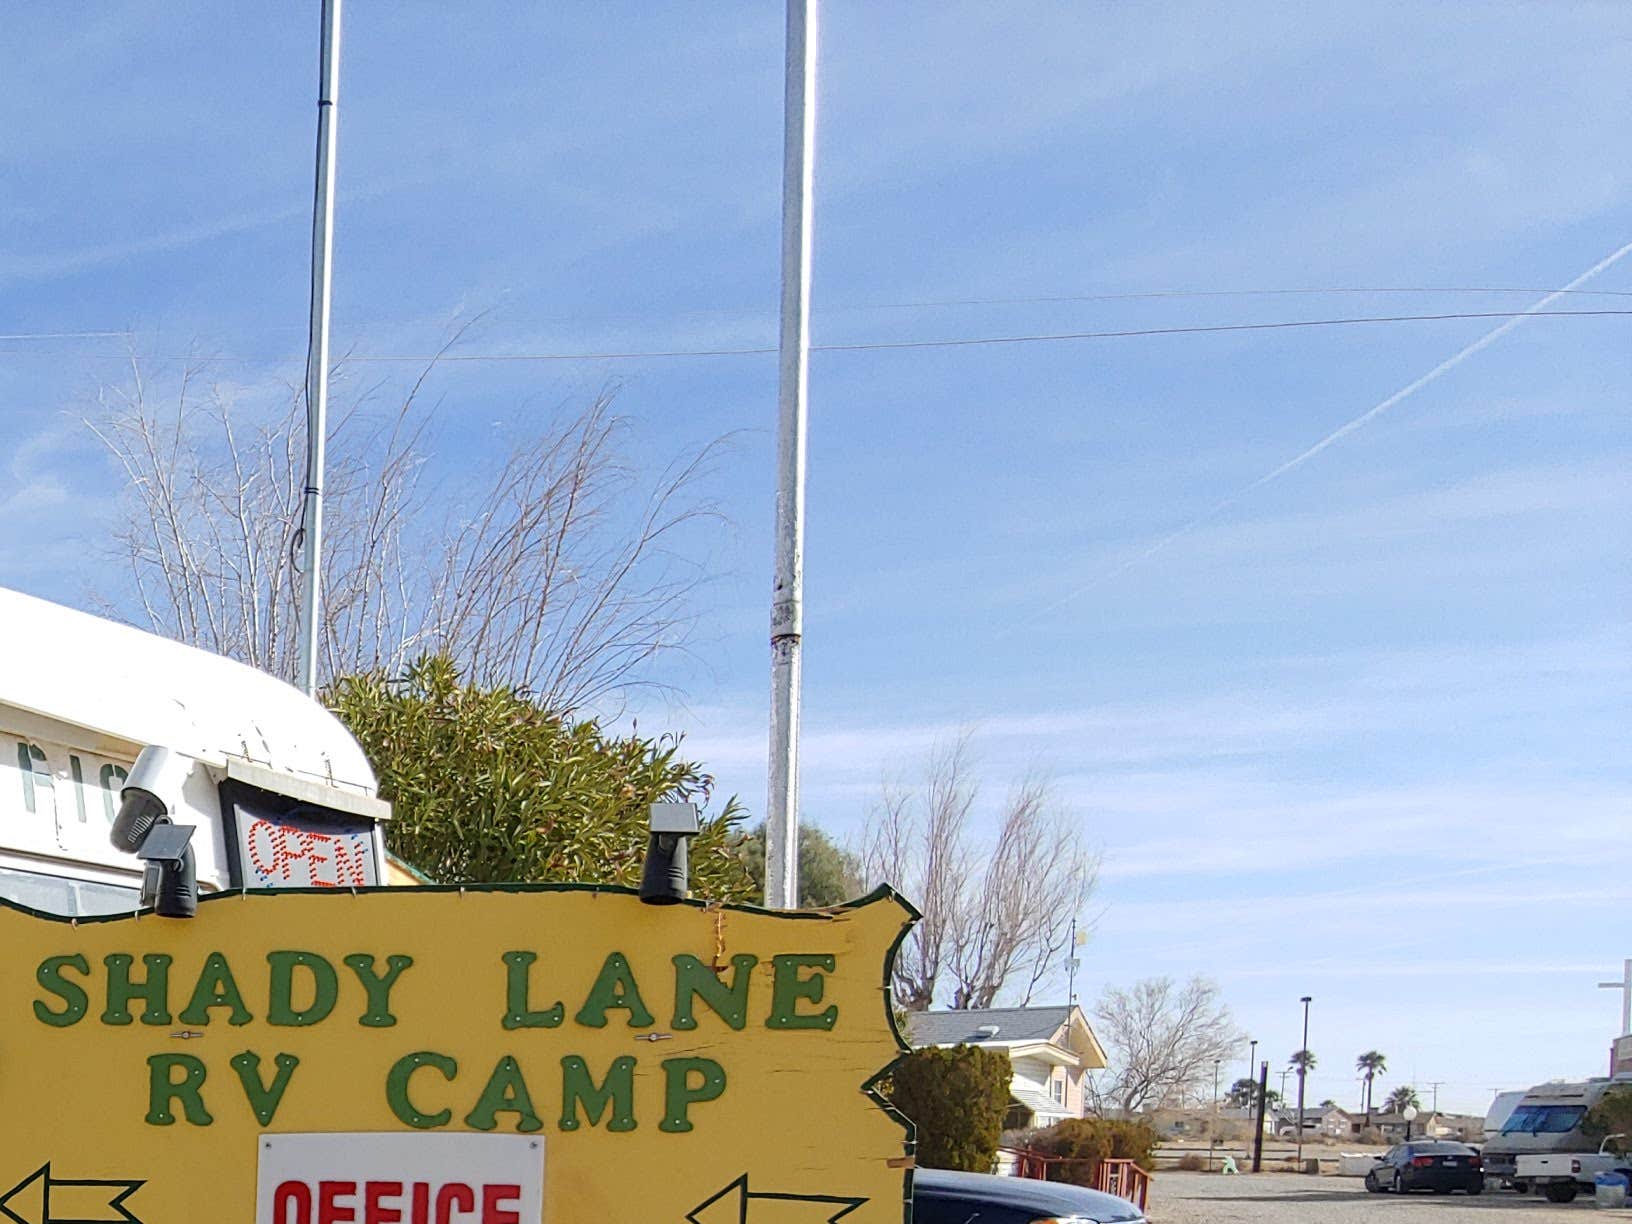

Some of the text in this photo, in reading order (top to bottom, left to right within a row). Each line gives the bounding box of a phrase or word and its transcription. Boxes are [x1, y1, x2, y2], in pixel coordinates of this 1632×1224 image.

[248, 819, 364, 886] OPEN
[33, 950, 839, 1031] SHADY LANE
[144, 1051, 728, 1133] RV CAMP
